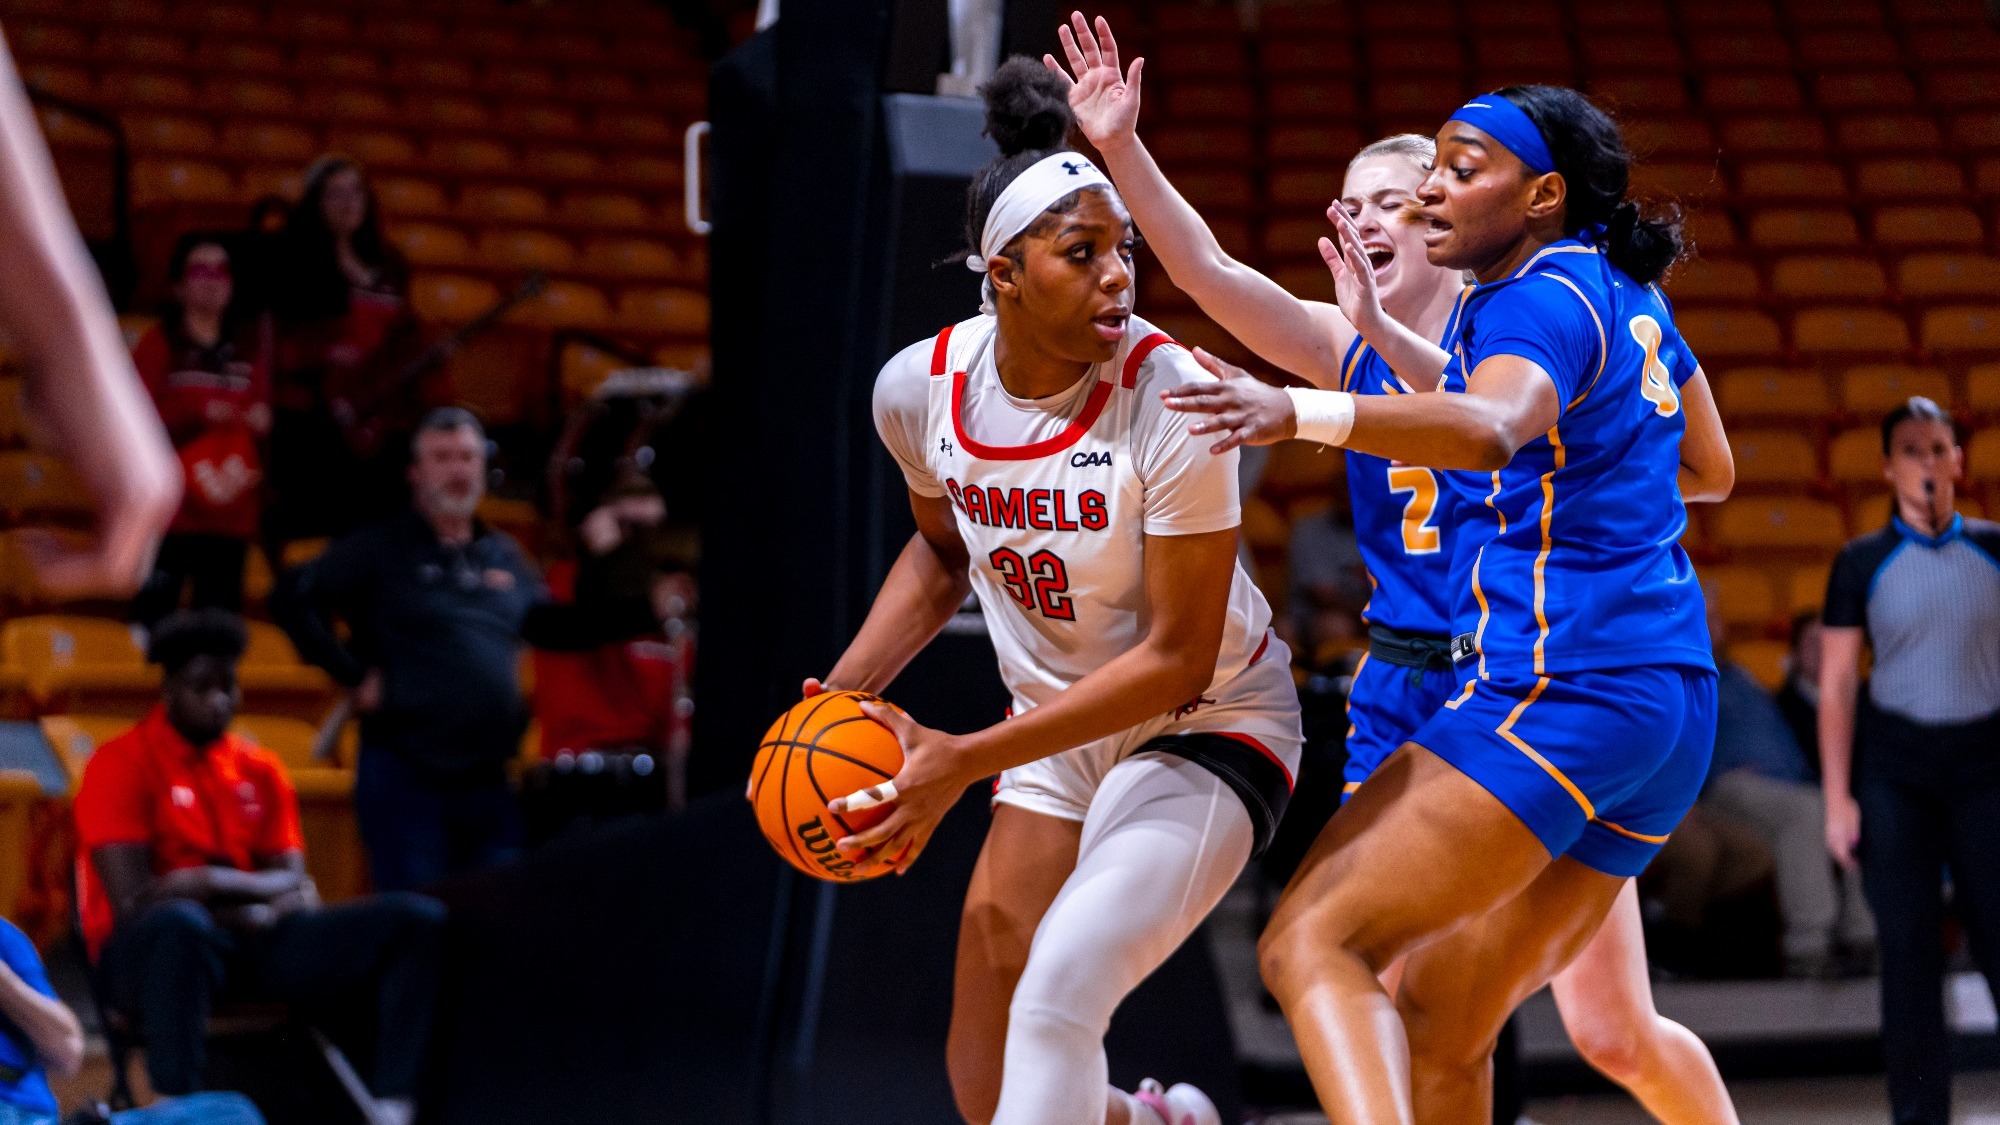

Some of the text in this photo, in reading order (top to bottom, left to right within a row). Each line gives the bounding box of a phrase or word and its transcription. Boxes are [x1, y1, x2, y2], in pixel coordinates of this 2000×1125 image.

[1070, 451, 1113, 468] CAA
[945, 477, 1109, 532] CAMELS
[1386, 465, 1441, 555] 2
[989, 546, 1076, 621] 32
